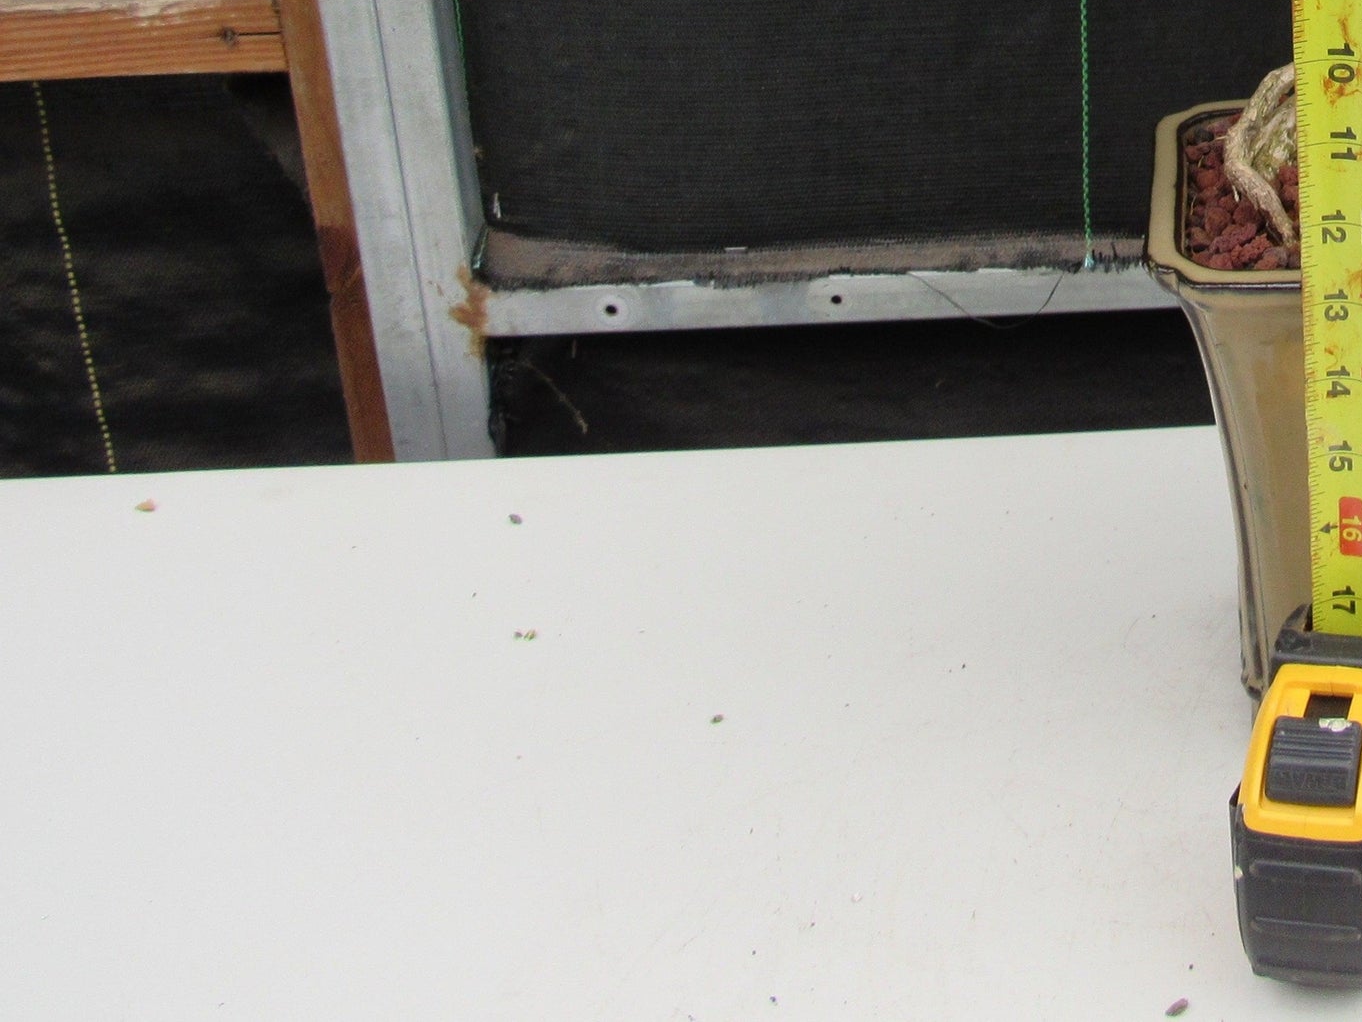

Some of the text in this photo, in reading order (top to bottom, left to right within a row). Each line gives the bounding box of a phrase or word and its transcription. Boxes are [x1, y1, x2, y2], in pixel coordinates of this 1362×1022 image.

[1327, 42, 1355, 84] 10
[1330, 127, 1357, 161] 11
[1321, 210, 1347, 244] 12
[1324, 289, 1349, 322] 13
[1326, 366, 1351, 399] 14
[1328, 440, 1353, 472] 15
[1341, 515, 1362, 542] 16
[1332, 585, 1356, 615] 17
